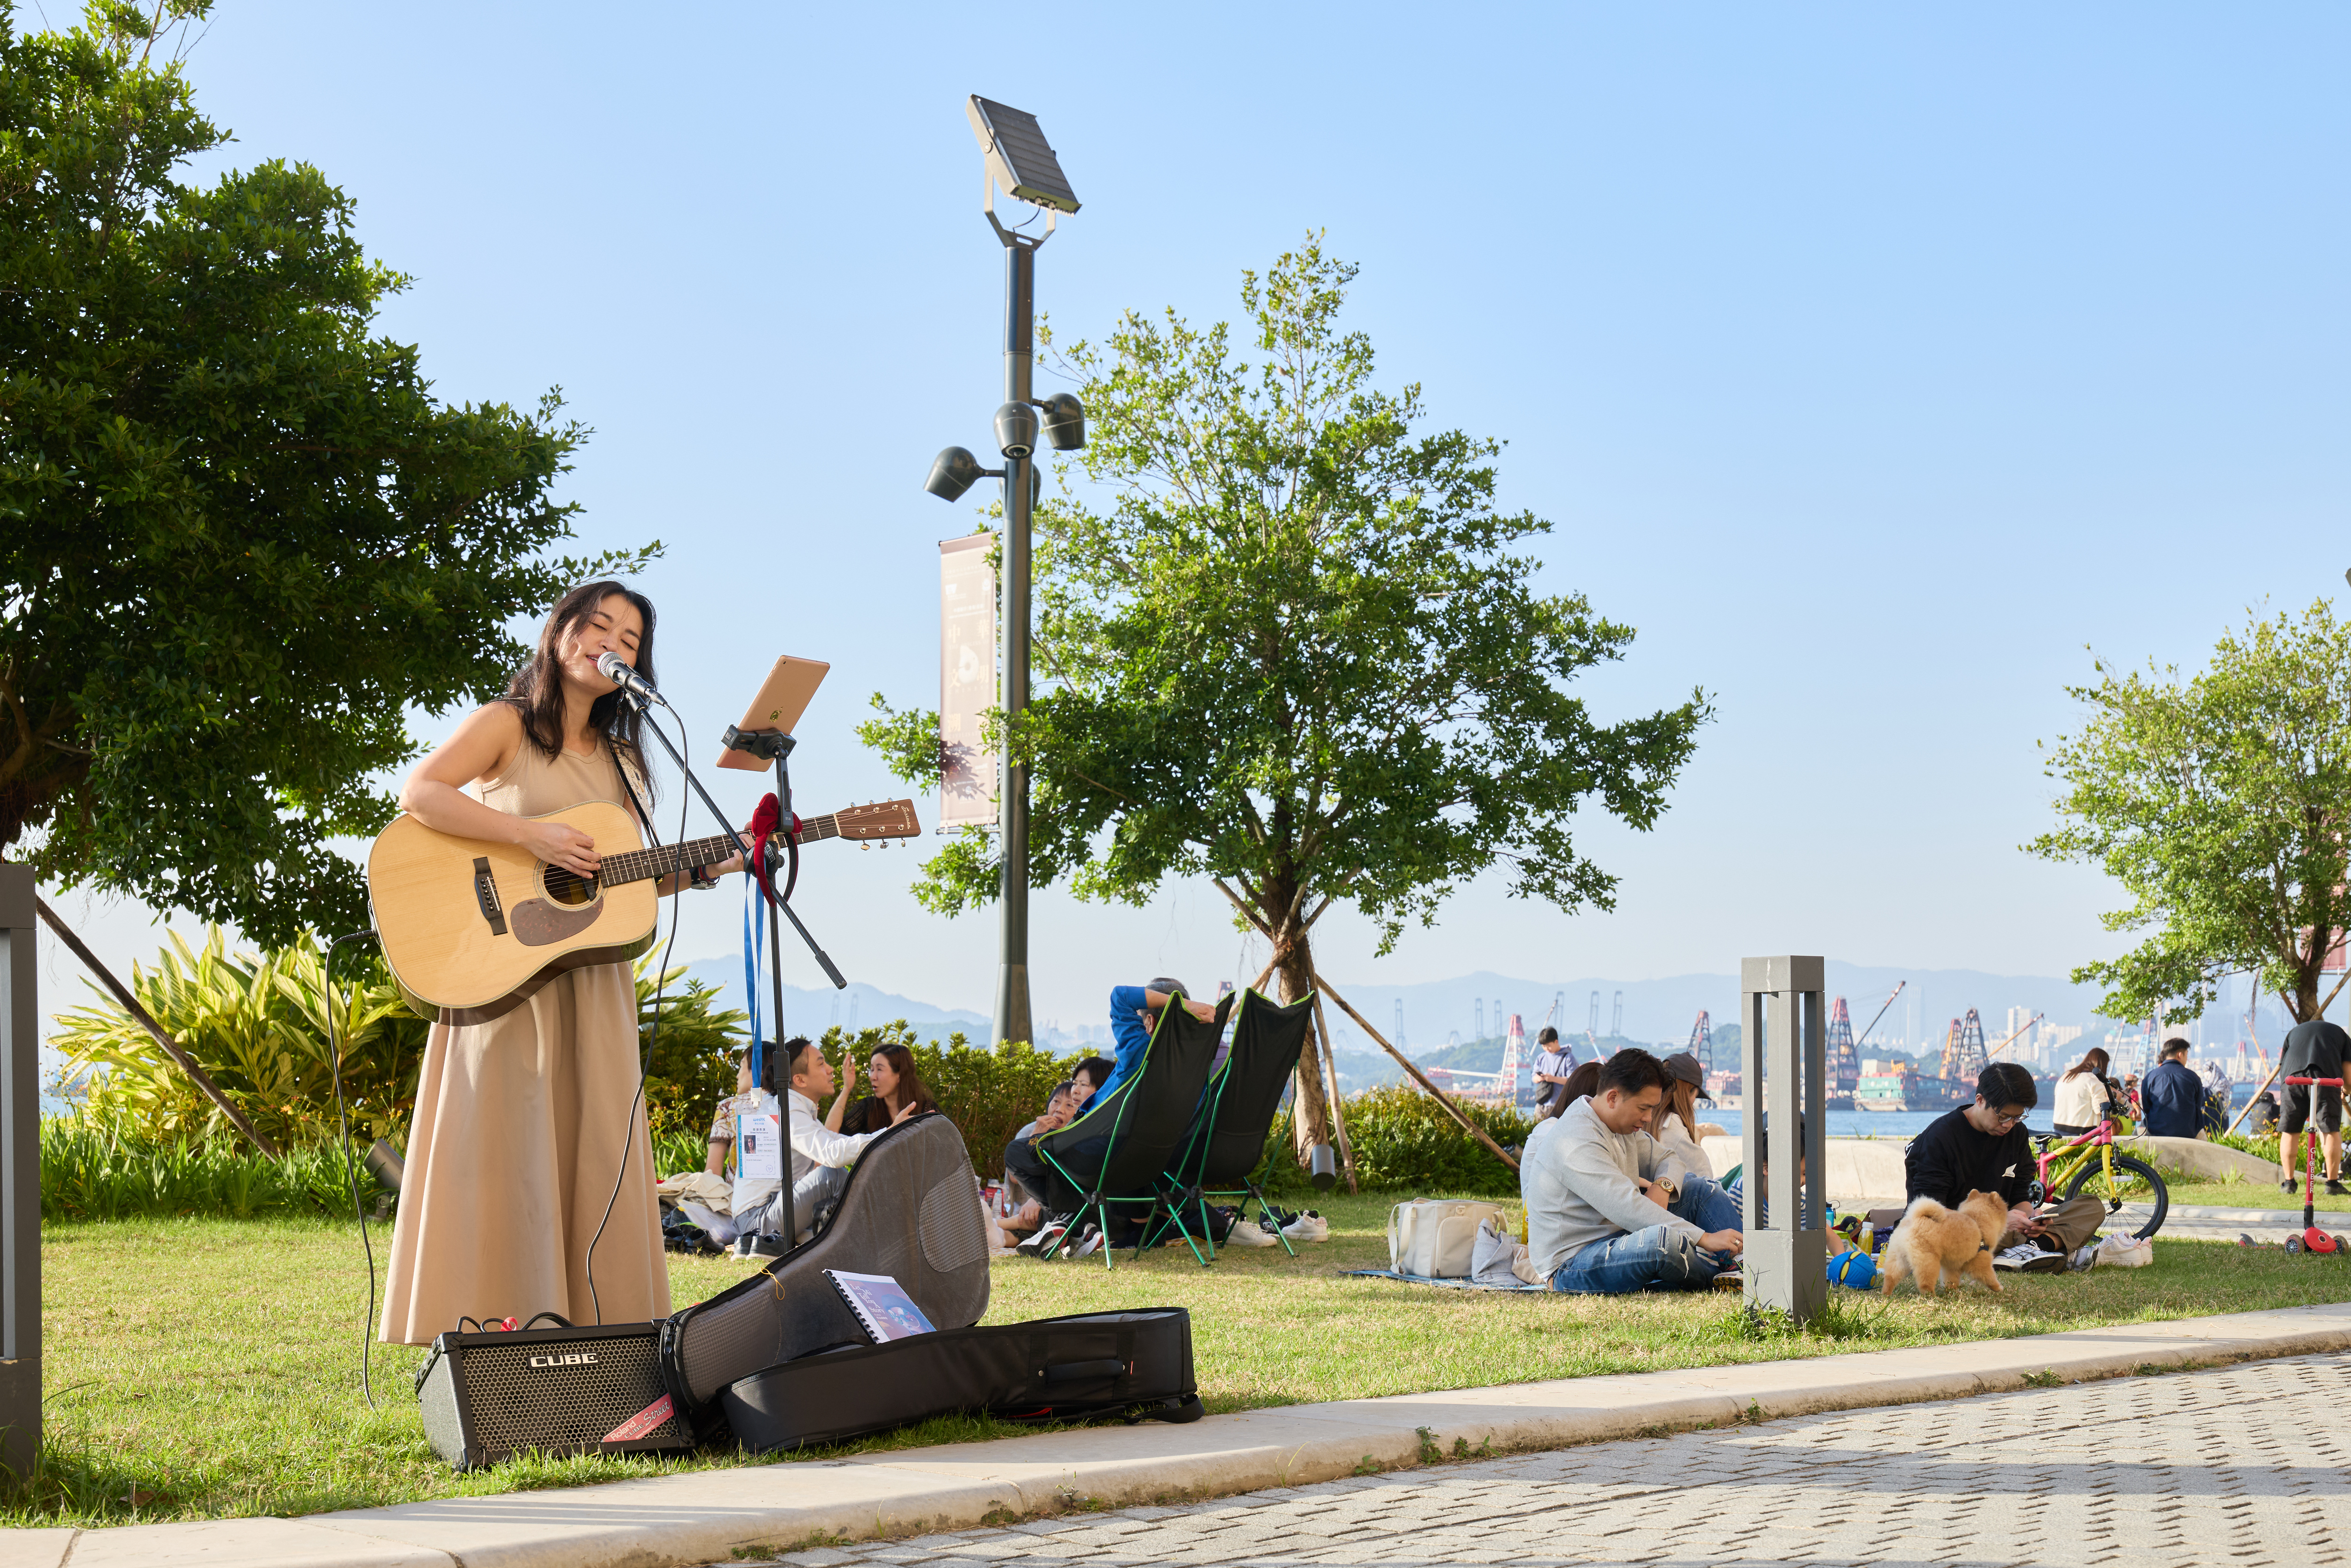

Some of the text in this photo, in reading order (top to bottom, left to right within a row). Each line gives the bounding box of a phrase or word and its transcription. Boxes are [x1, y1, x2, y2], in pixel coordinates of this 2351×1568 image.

[530, 1353, 599, 1368] CUBE
[643, 1401, 670, 1426] Street
[610, 1420, 637, 1441] Roland
[624, 1423, 645, 1439] CUBE
